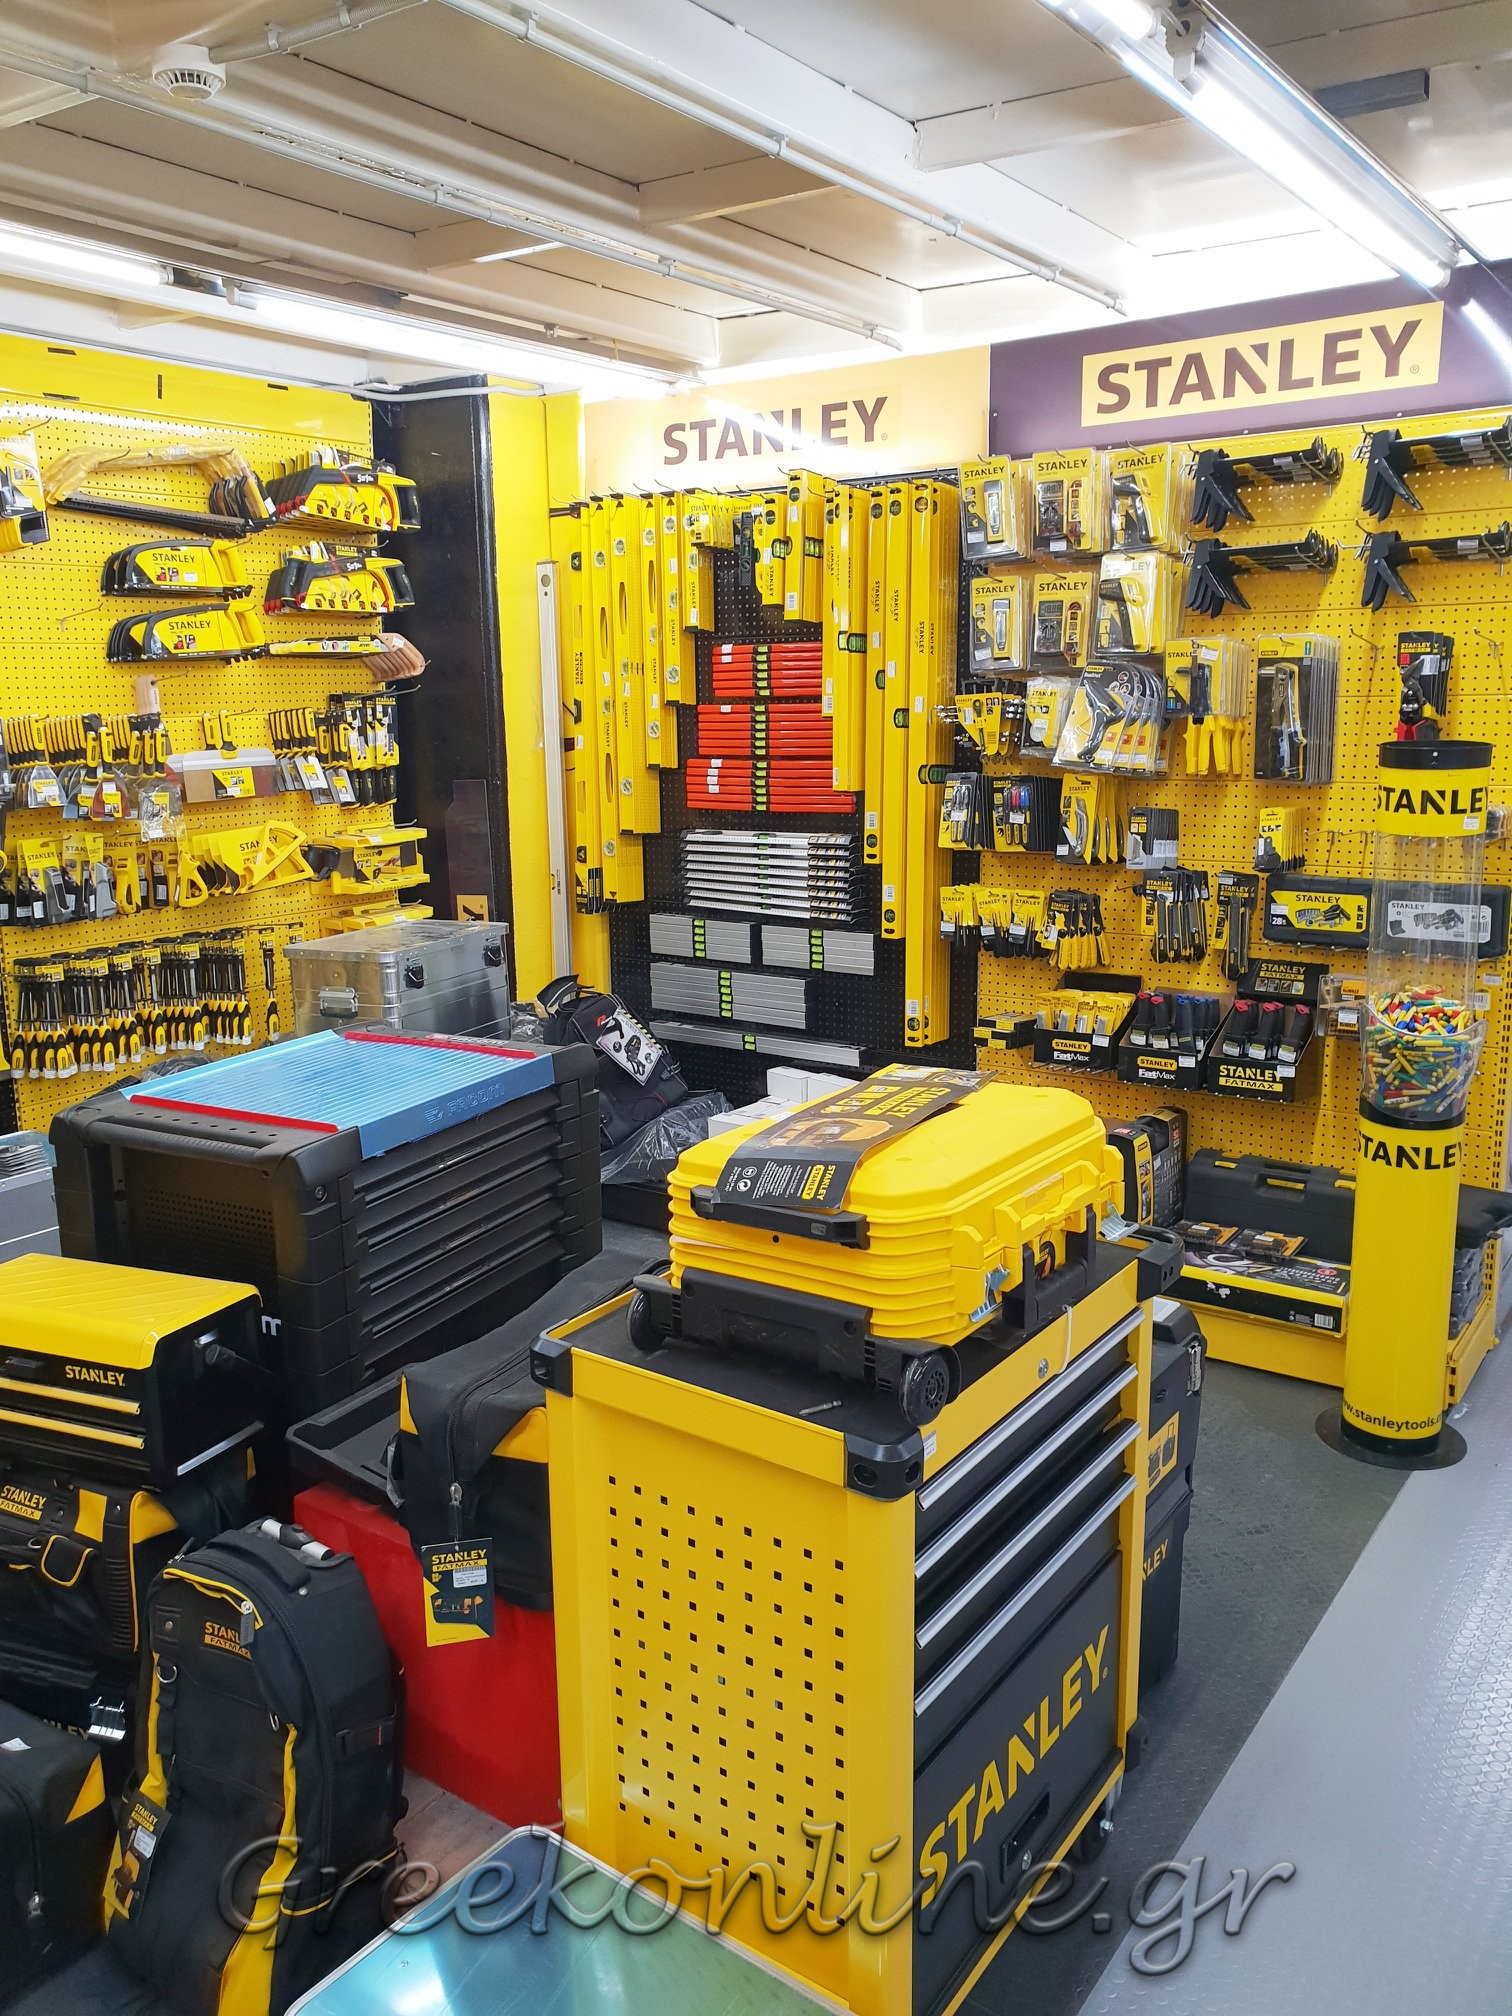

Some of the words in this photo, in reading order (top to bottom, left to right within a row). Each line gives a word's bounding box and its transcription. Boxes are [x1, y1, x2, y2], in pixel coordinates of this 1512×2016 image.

[1097, 319, 1423, 414] STANLEY
[1037, 459, 1088, 472] STANLEY
[1117, 454, 1165, 469] STANLEY
[964, 466, 1005, 479] STANLEY
[152, 552, 195, 564] STANLEY
[975, 585, 1015, 595] STANLEY
[1038, 581, 1088, 592] STANLEY
[168, 620, 211, 631] STANLEY
[1068, 785, 1091, 793] STANLEY
[1377, 786, 1488, 816] TANLE
[27, 852, 55, 861] STANLEY
[1296, 894, 1340, 904] STANLEY
[1391, 902, 1425, 910] STANLEY
[1260, 963, 1306, 974] STANLEY
[1055, 1041, 1087, 1050] STANLEY
[1139, 1058, 1175, 1068] STANLEY
[1219, 1065, 1282, 1082] STANLEY
[1225, 1078, 1275, 1090] FATMAX
[886, 1087, 951, 1118] STANLEY
[1358, 1130, 1462, 1170] TANLE
[806, 1166, 820, 1197] STANLEY
[817, 1165, 836, 1200] STANLEY
[65, 1365, 125, 1387] STANLEY
[1, 1485, 47, 1509] STANLEY
[0, 1500, 36, 1517] FATMAX
[431, 1549, 487, 1565] STANLEY
[436, 1560, 480, 1571] FATMAX
[205, 1621, 240, 1644] STANL
[919, 1623, 1109, 1911] STANLEY
[134, 1803, 158, 1825] STANLEY
